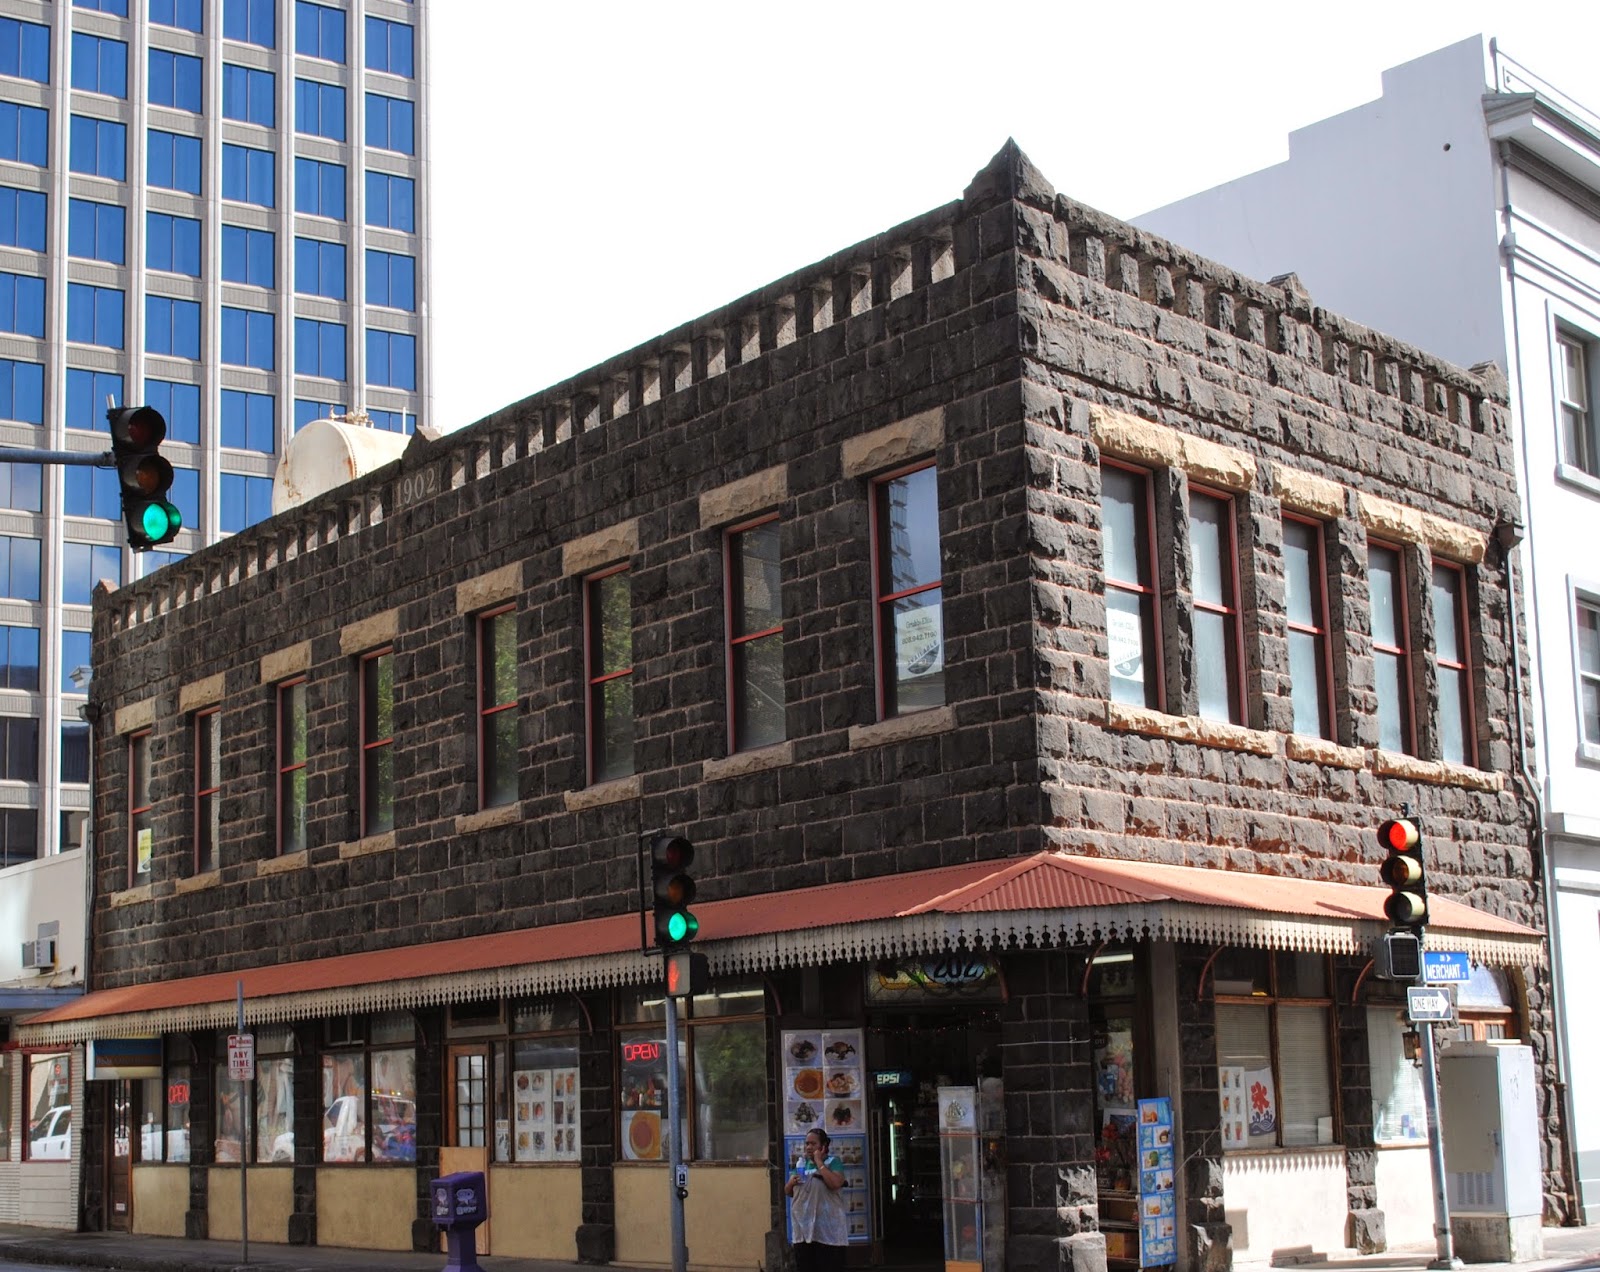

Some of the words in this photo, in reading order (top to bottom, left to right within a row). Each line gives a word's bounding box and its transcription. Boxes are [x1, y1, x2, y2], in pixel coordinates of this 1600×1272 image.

[396, 467, 436, 508] 1902
[1426, 964, 1461, 979] MERCHANT
[1414, 998, 1426, 1009] ONE
[1427, 998, 1439, 1009] WAY
[234, 1051, 248, 1059] ANY
[624, 1042, 659, 1061] OPEN
[876, 1073, 900, 1084] EPSI
[168, 1084, 189, 1104] OPEN
